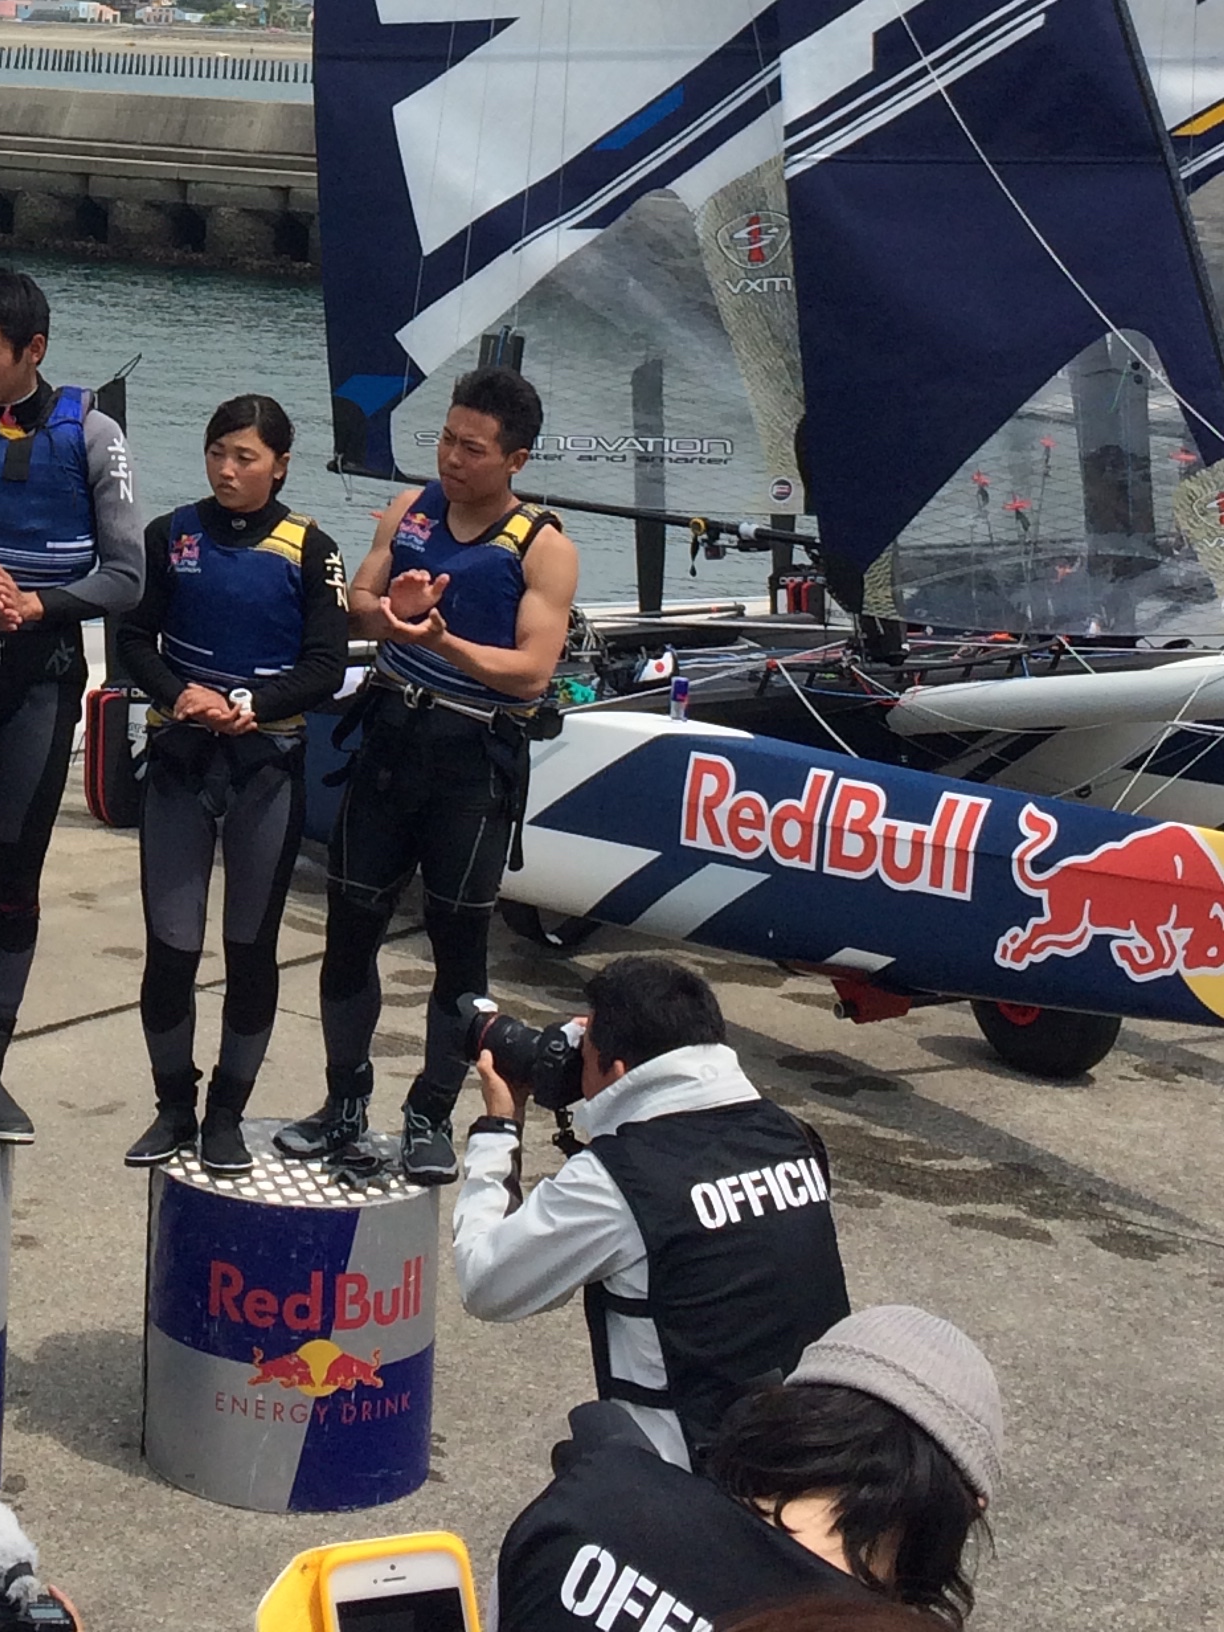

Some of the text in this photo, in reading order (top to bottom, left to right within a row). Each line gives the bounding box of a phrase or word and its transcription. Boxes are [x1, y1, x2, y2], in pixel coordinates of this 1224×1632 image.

[683, 755, 988, 897] Red Bull
[208, 1255, 422, 1331] Red Bull
[215, 1391, 411, 1425] ENERGY DRINK
[560, 1544, 713, 1632] OFF
